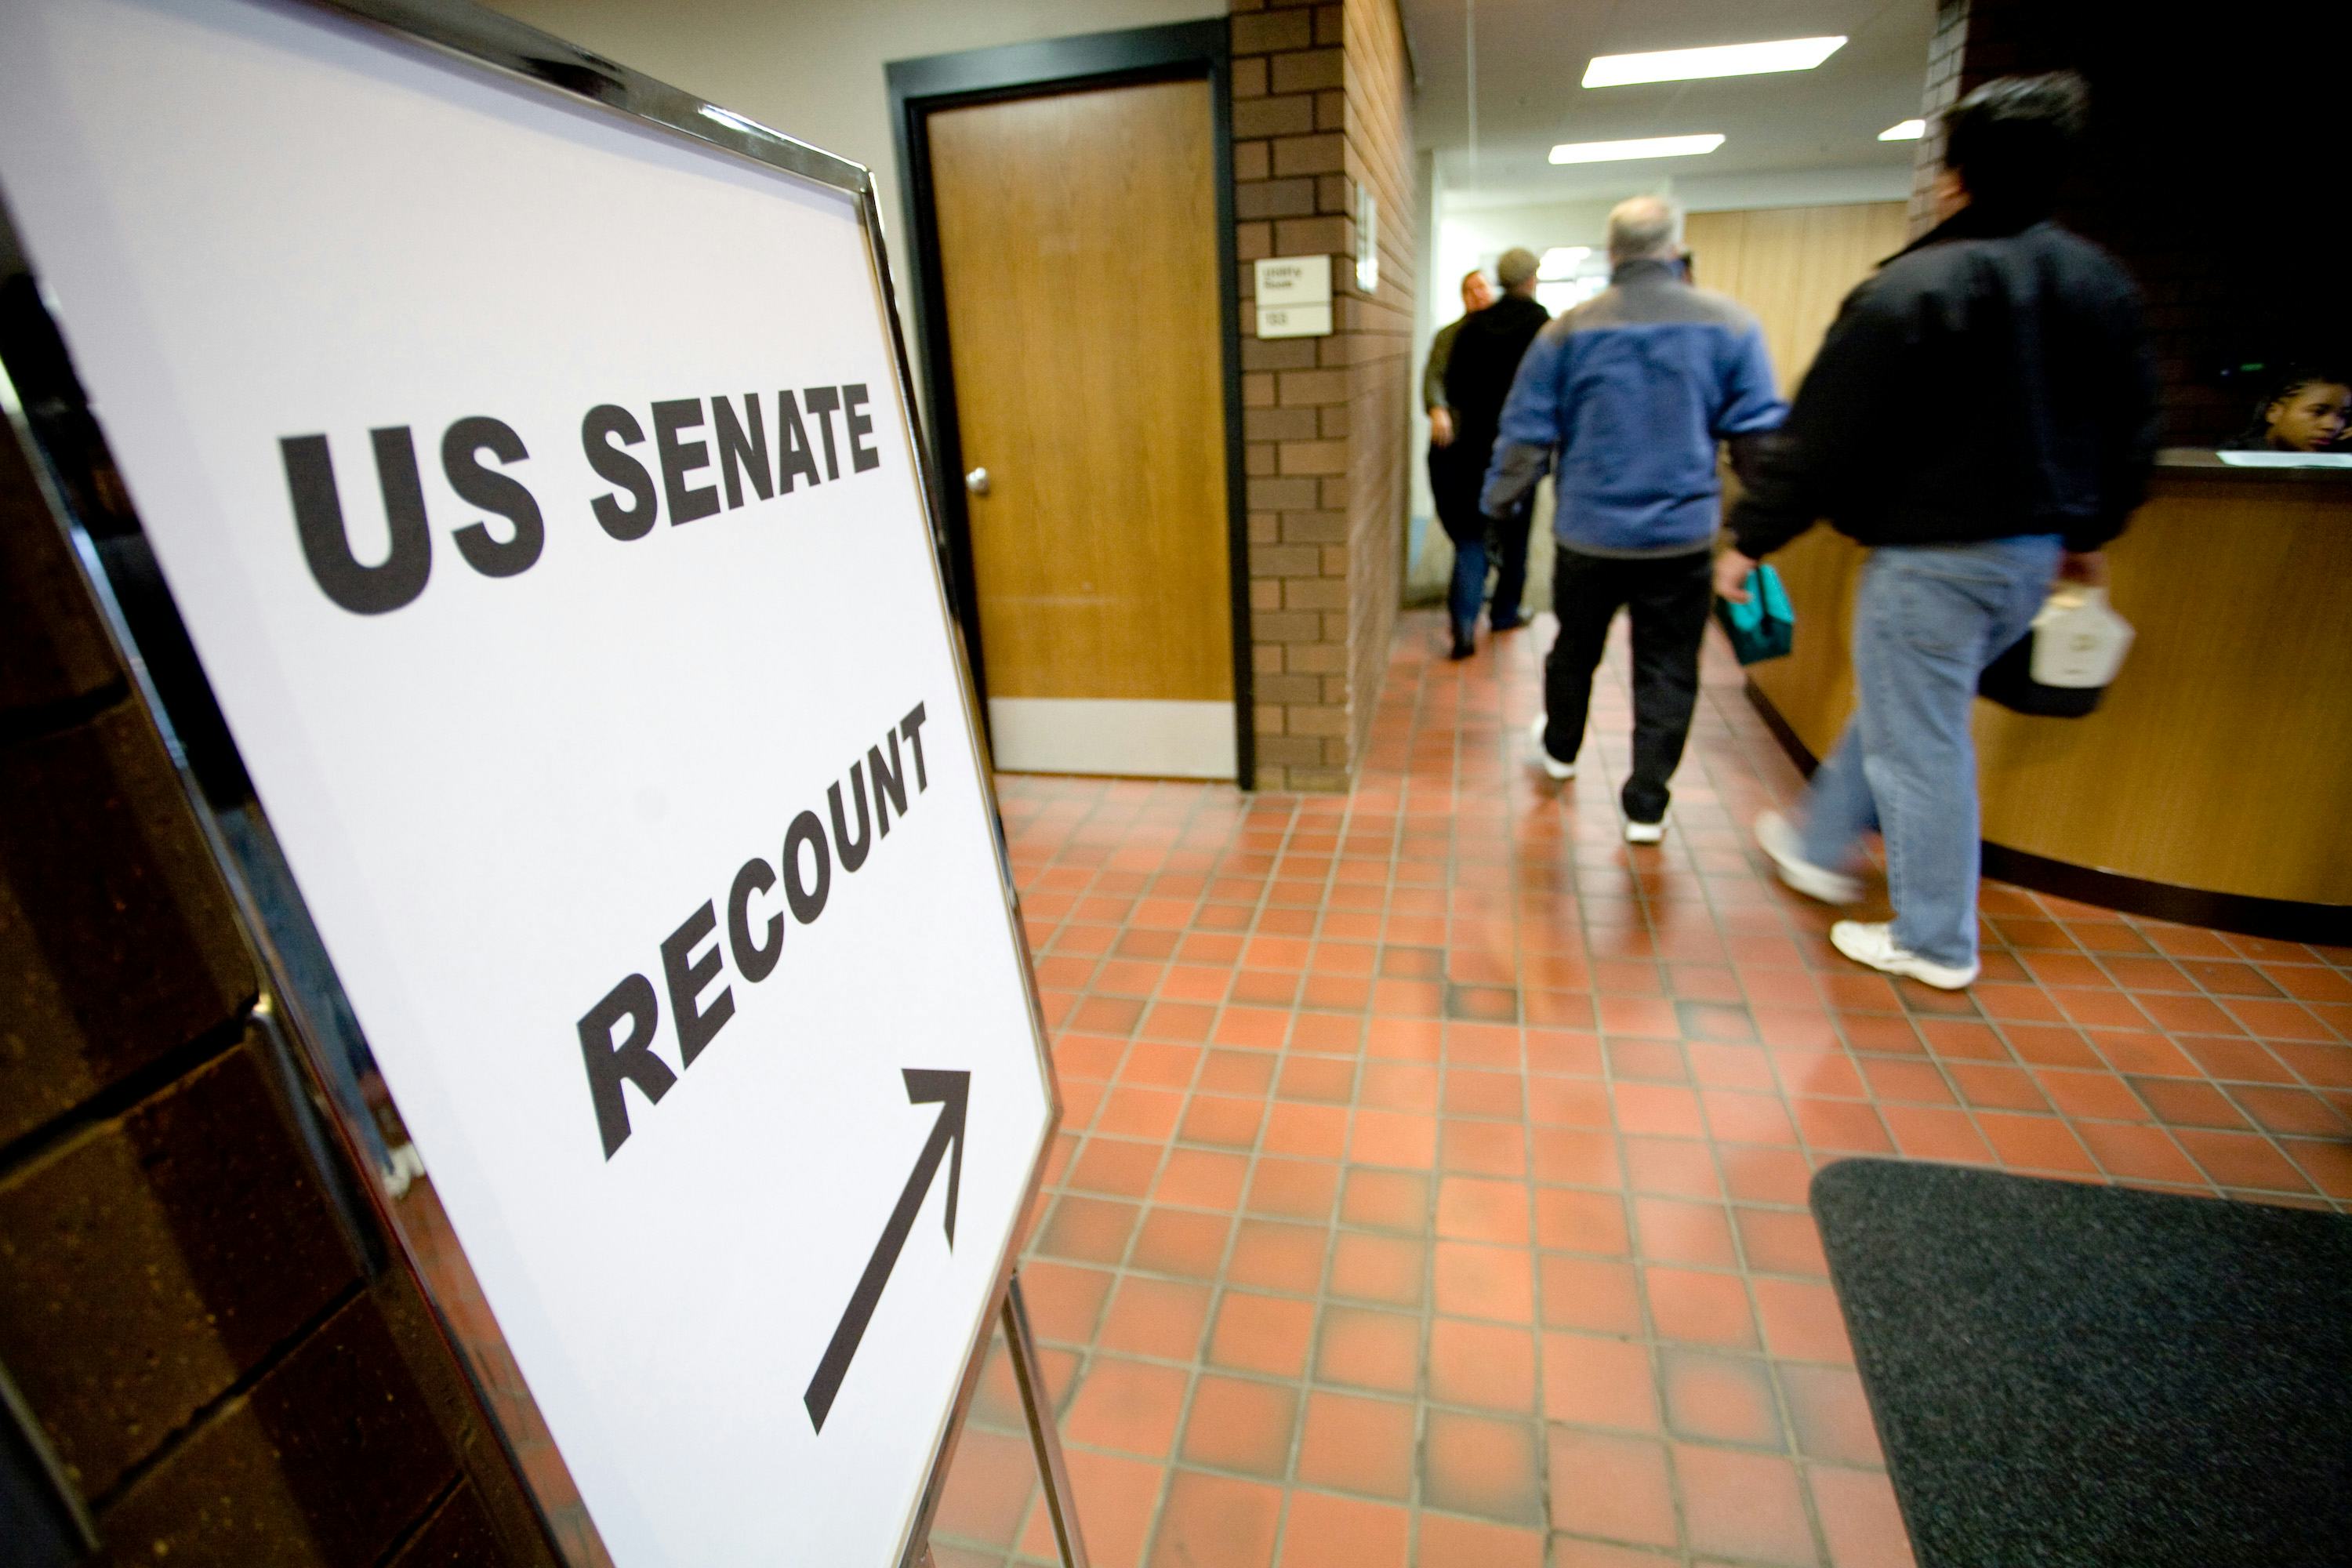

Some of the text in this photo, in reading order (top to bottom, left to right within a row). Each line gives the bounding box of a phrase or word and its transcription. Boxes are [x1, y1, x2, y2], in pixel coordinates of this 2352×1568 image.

[278, 383, 880, 615] US SENATE
[577, 701, 927, 1161] RECOUNT
